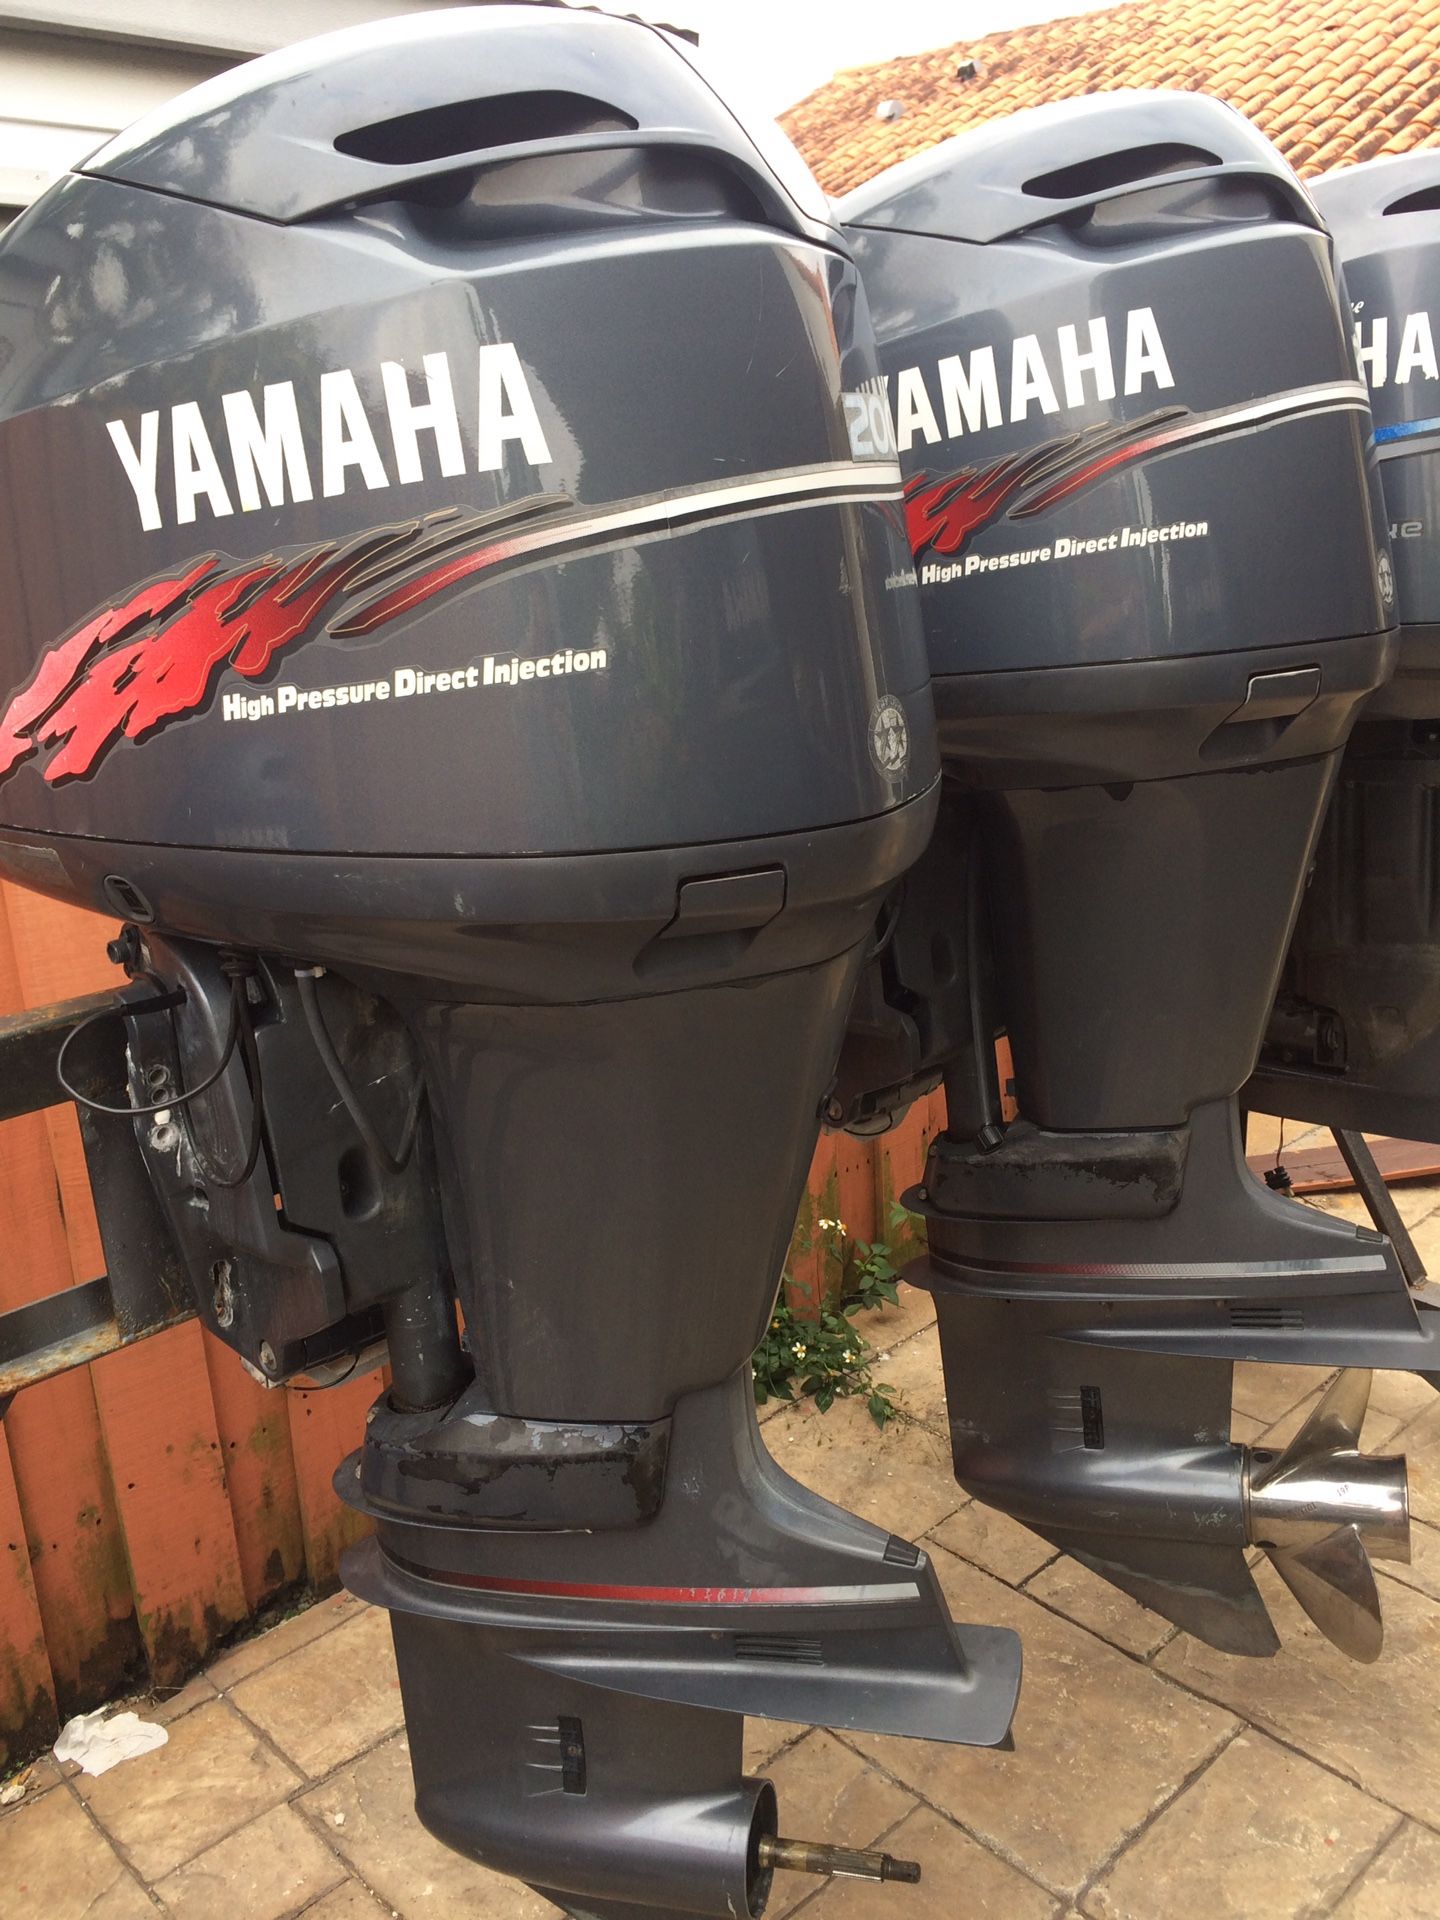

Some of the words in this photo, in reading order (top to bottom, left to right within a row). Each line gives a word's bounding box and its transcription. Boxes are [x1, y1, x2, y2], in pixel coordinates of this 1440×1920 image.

[884, 307, 1175, 453] AMAHA
[106, 342, 553, 532] YAMAHA
[921, 563, 962, 585] High
[964, 547, 1051, 576] Pressure
[1054, 534, 1118, 559] Direct
[1120, 521, 1209, 547] Injection
[222, 693, 275, 722] High
[277, 680, 391, 714] Pressure
[394, 665, 479, 698] Direct
[483, 649, 607, 686] Injection
